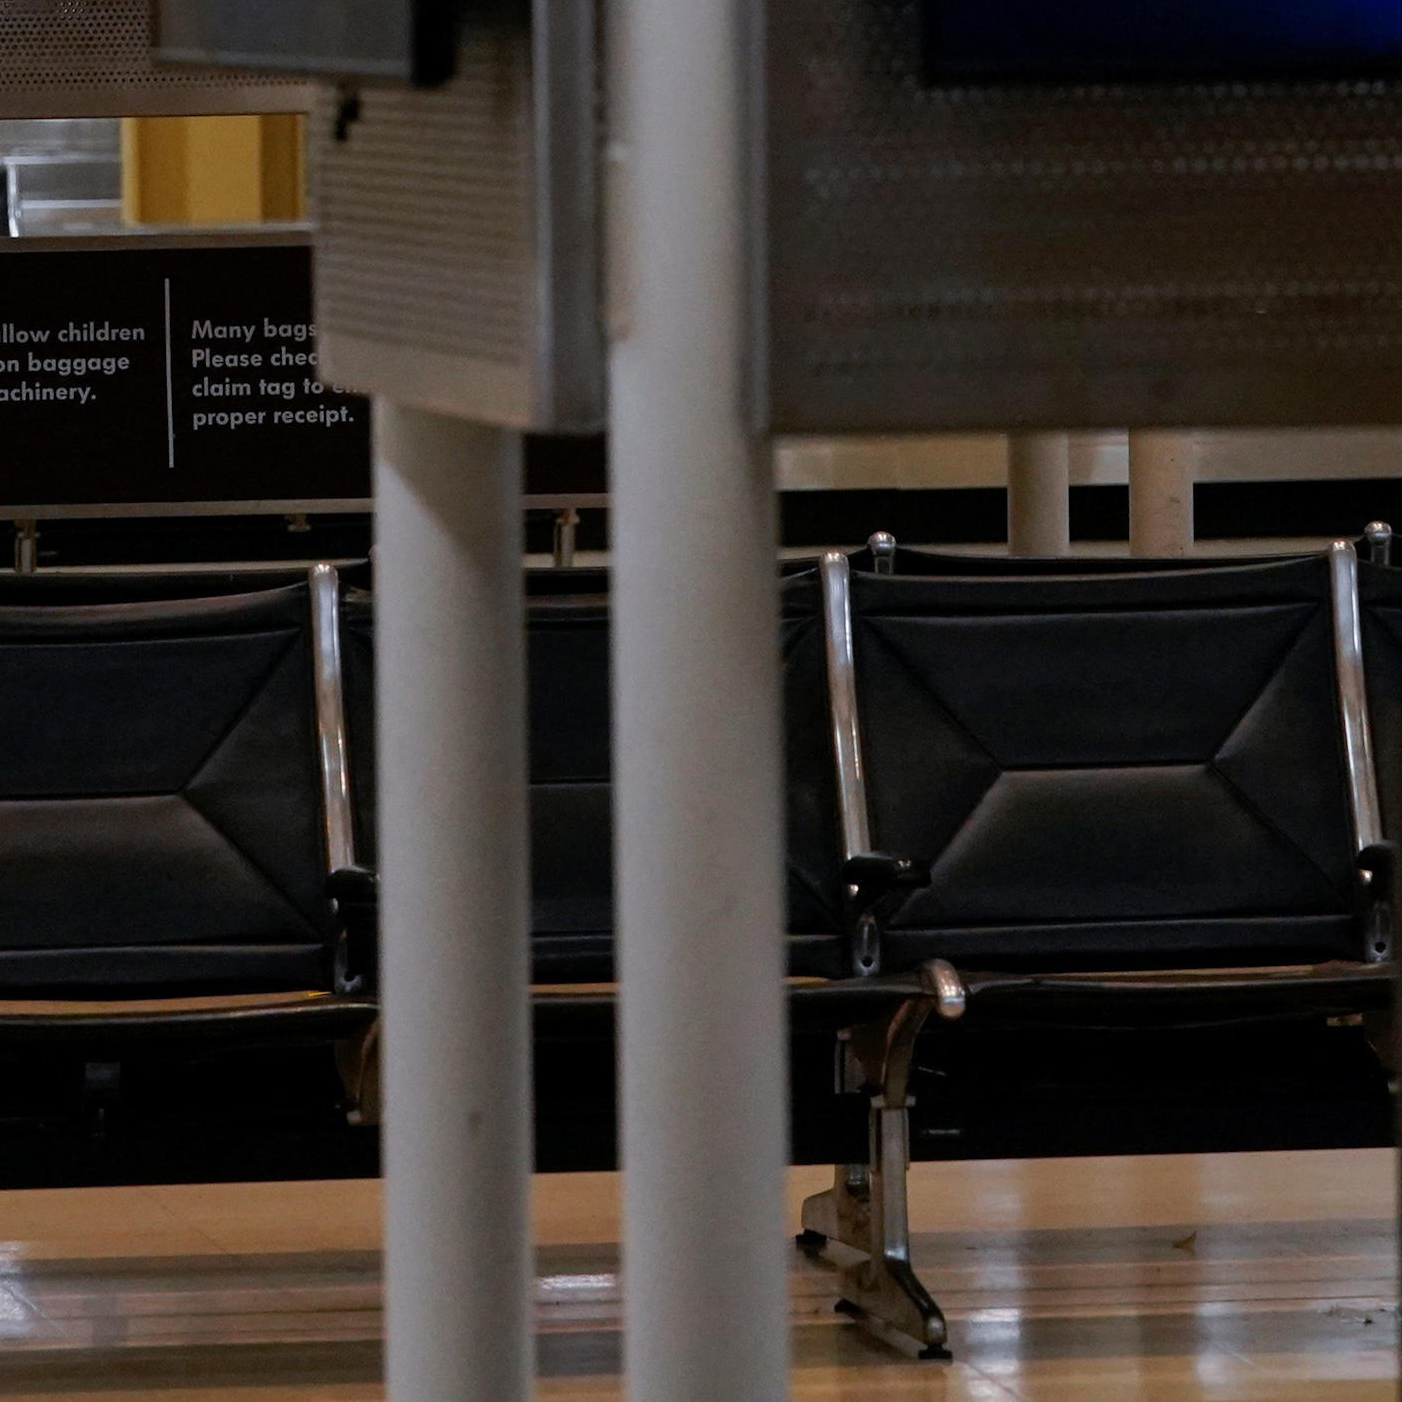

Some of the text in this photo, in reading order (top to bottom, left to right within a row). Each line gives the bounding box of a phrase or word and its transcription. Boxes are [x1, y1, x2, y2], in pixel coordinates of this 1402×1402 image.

[58, 322, 144, 342] children
[192, 318, 316, 342] Many bags
[28, 352, 129, 375] baggage
[193, 346, 319, 367] Please chec
[192, 377, 251, 396] claim
[259, 379, 295, 399] tag
[303, 378, 324, 394] to
[194, 405, 353, 430] proper receipt.
